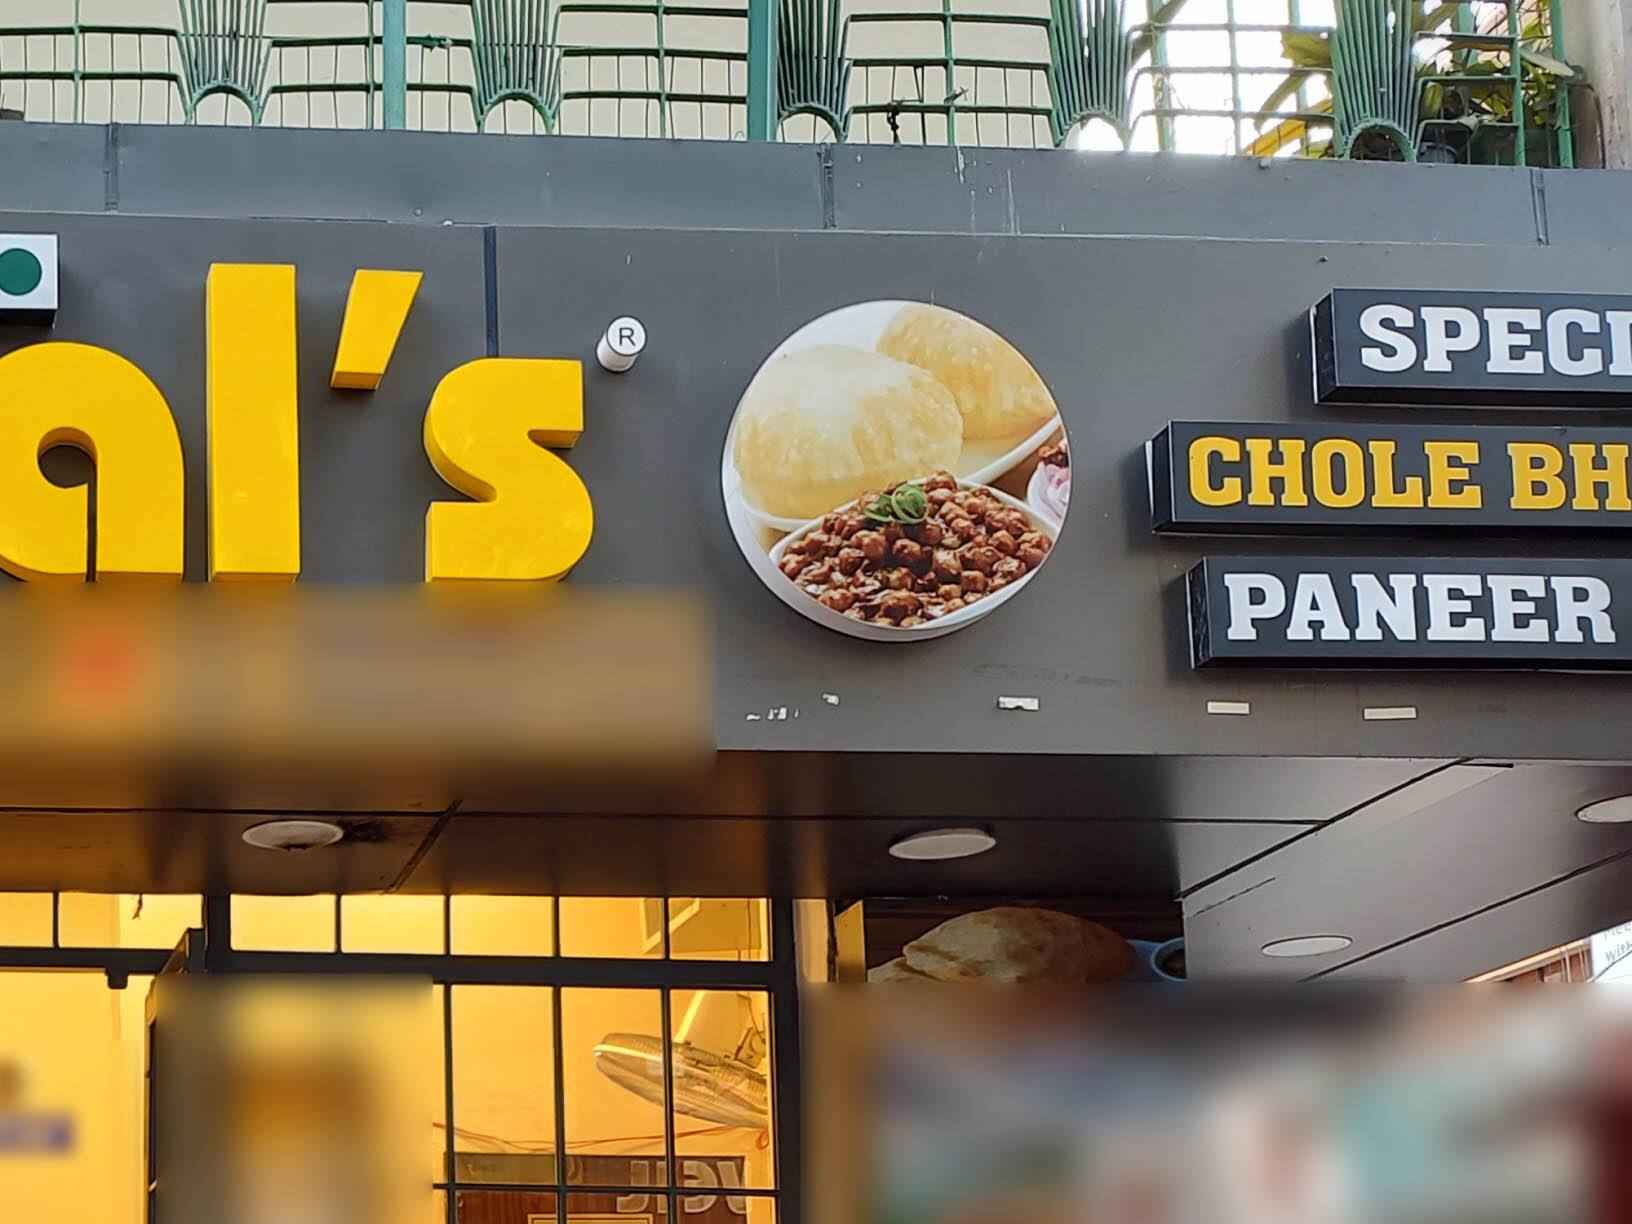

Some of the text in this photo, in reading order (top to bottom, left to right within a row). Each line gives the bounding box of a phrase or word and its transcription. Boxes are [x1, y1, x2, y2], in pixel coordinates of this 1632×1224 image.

[1187, 436, 1632, 511] CHOLE BH
[1222, 572, 1617, 644] PANEER
